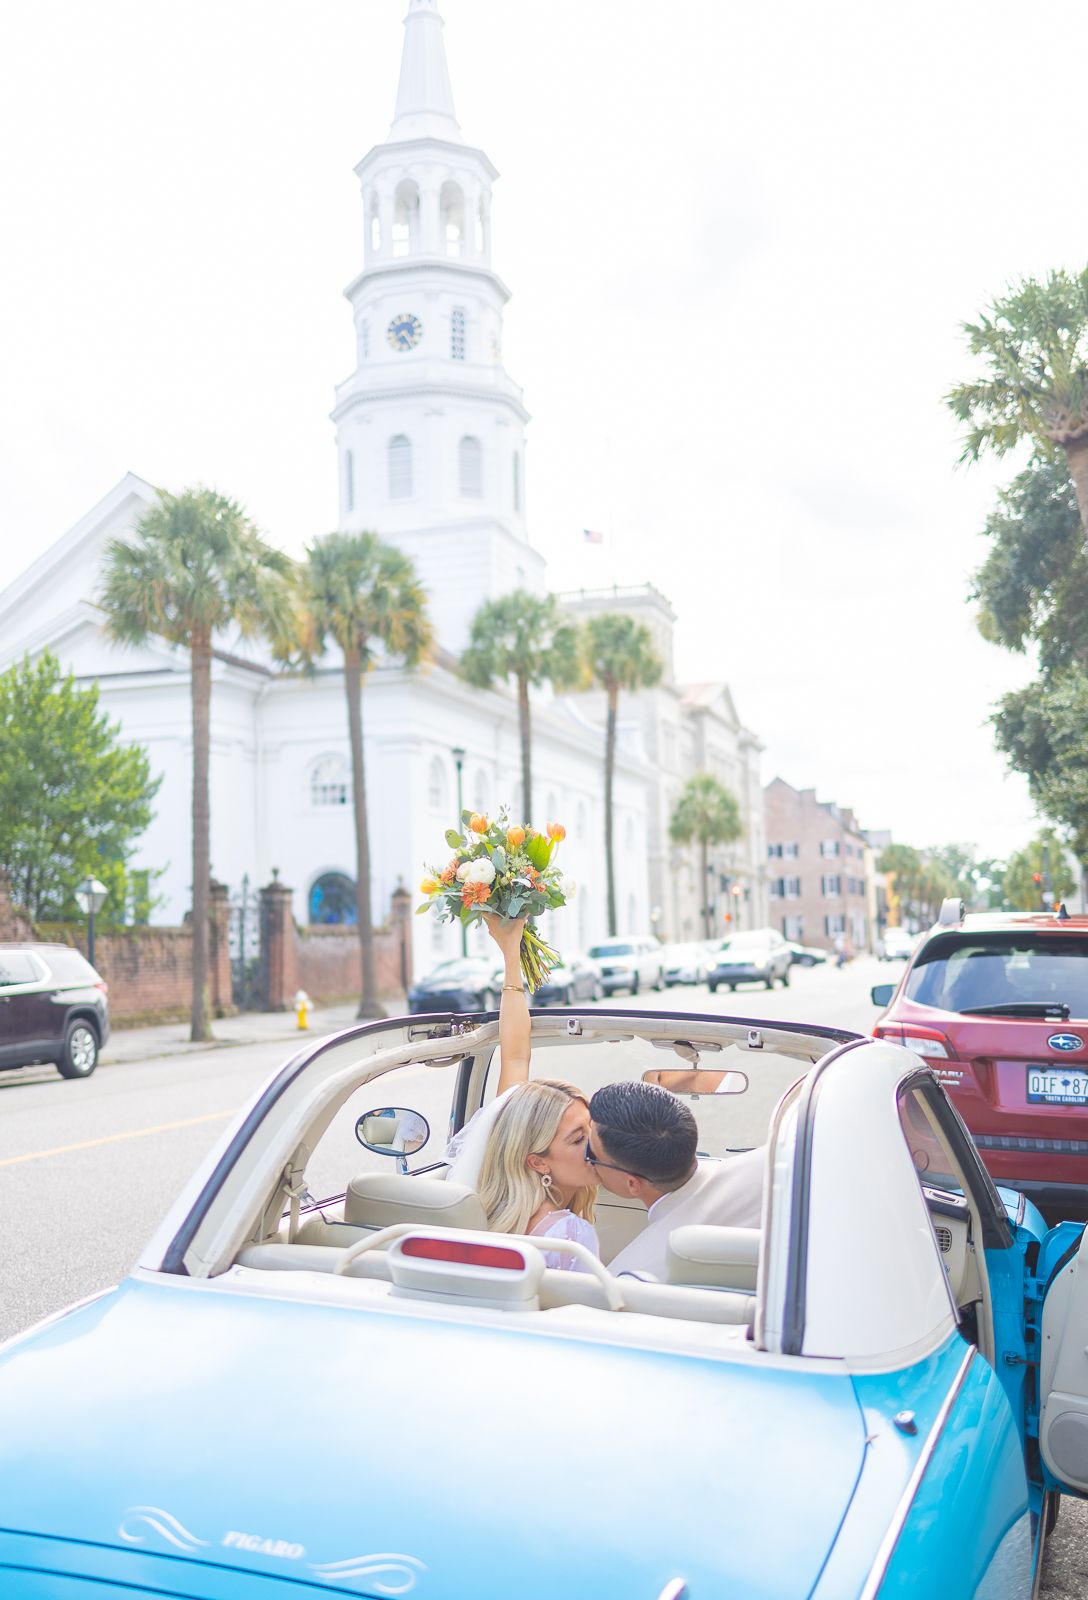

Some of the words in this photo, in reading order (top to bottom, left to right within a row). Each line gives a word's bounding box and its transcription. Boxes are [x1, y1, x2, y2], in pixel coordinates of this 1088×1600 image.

[933, 1070, 964, 1078] BARU
[1032, 1076, 1057, 1093] QIF
[223, 1531, 305, 1560] FIGARO
